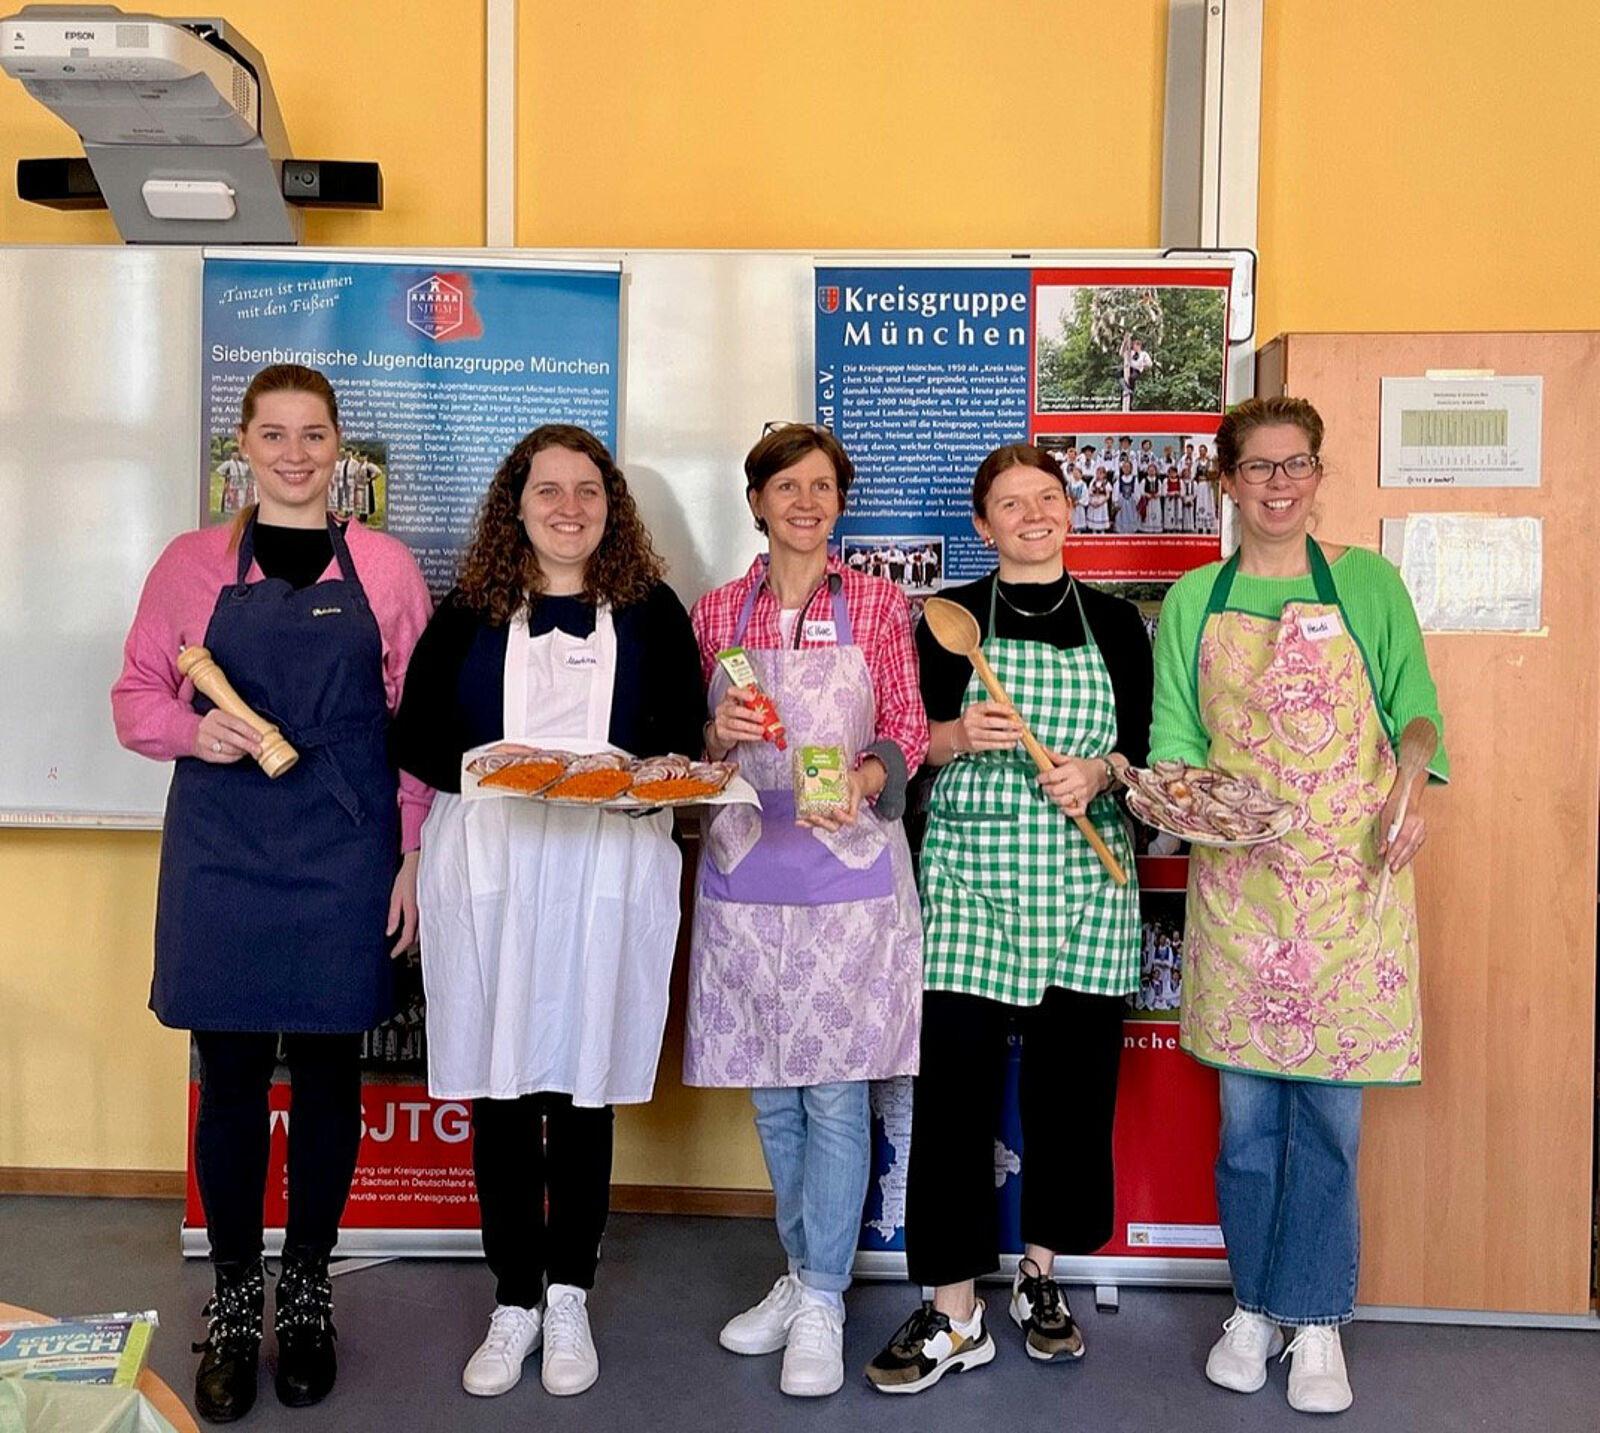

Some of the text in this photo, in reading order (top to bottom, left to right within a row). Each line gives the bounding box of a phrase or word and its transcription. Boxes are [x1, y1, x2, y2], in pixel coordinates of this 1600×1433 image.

[65, 32, 95, 40] EPSON
[278, 282, 293, 295] ist
[297, 275, 353, 293] träumen
[845, 284, 1027, 318] Kreisgruppe
[237, 306, 260, 320] mit
[263, 299, 288, 316] den
[843, 318, 1026, 347] München
[211, 344, 610, 375] Siebenbürgische Jugendtanzgruppe München
[843, 364, 857, 373] Die
[859, 364, 905, 374] Kreisgruppe
[843, 375, 862, 384] chen
[863, 375, 884, 384] Stadt
[885, 375, 901, 384] und
[1010, 375, 1026, 384] sich
[915, 386, 931, 395] und
[995, 386, 1026, 397] gehören
[984, 397, 999, 406] und
[1017, 397, 1026, 406] in
[843, 408, 863, 417] Stadt
[864, 408, 880, 417] und
[921, 408, 957, 417] München
[918, 420, 931, 429] die
[843, 431, 858, 440] und
[916, 431, 932, 440] und
[937, 464, 953, 473] und
[377, 1166, 391, 1175] der
[393, 1166, 447, 1177] Kreisgruppe
[361, 1176, 466, 1188] Sachsen in Deutschland
[350, 1191, 467, 1204] wurde von der Kreisgruppe
[16, 1337, 121, 1358] TUCH
